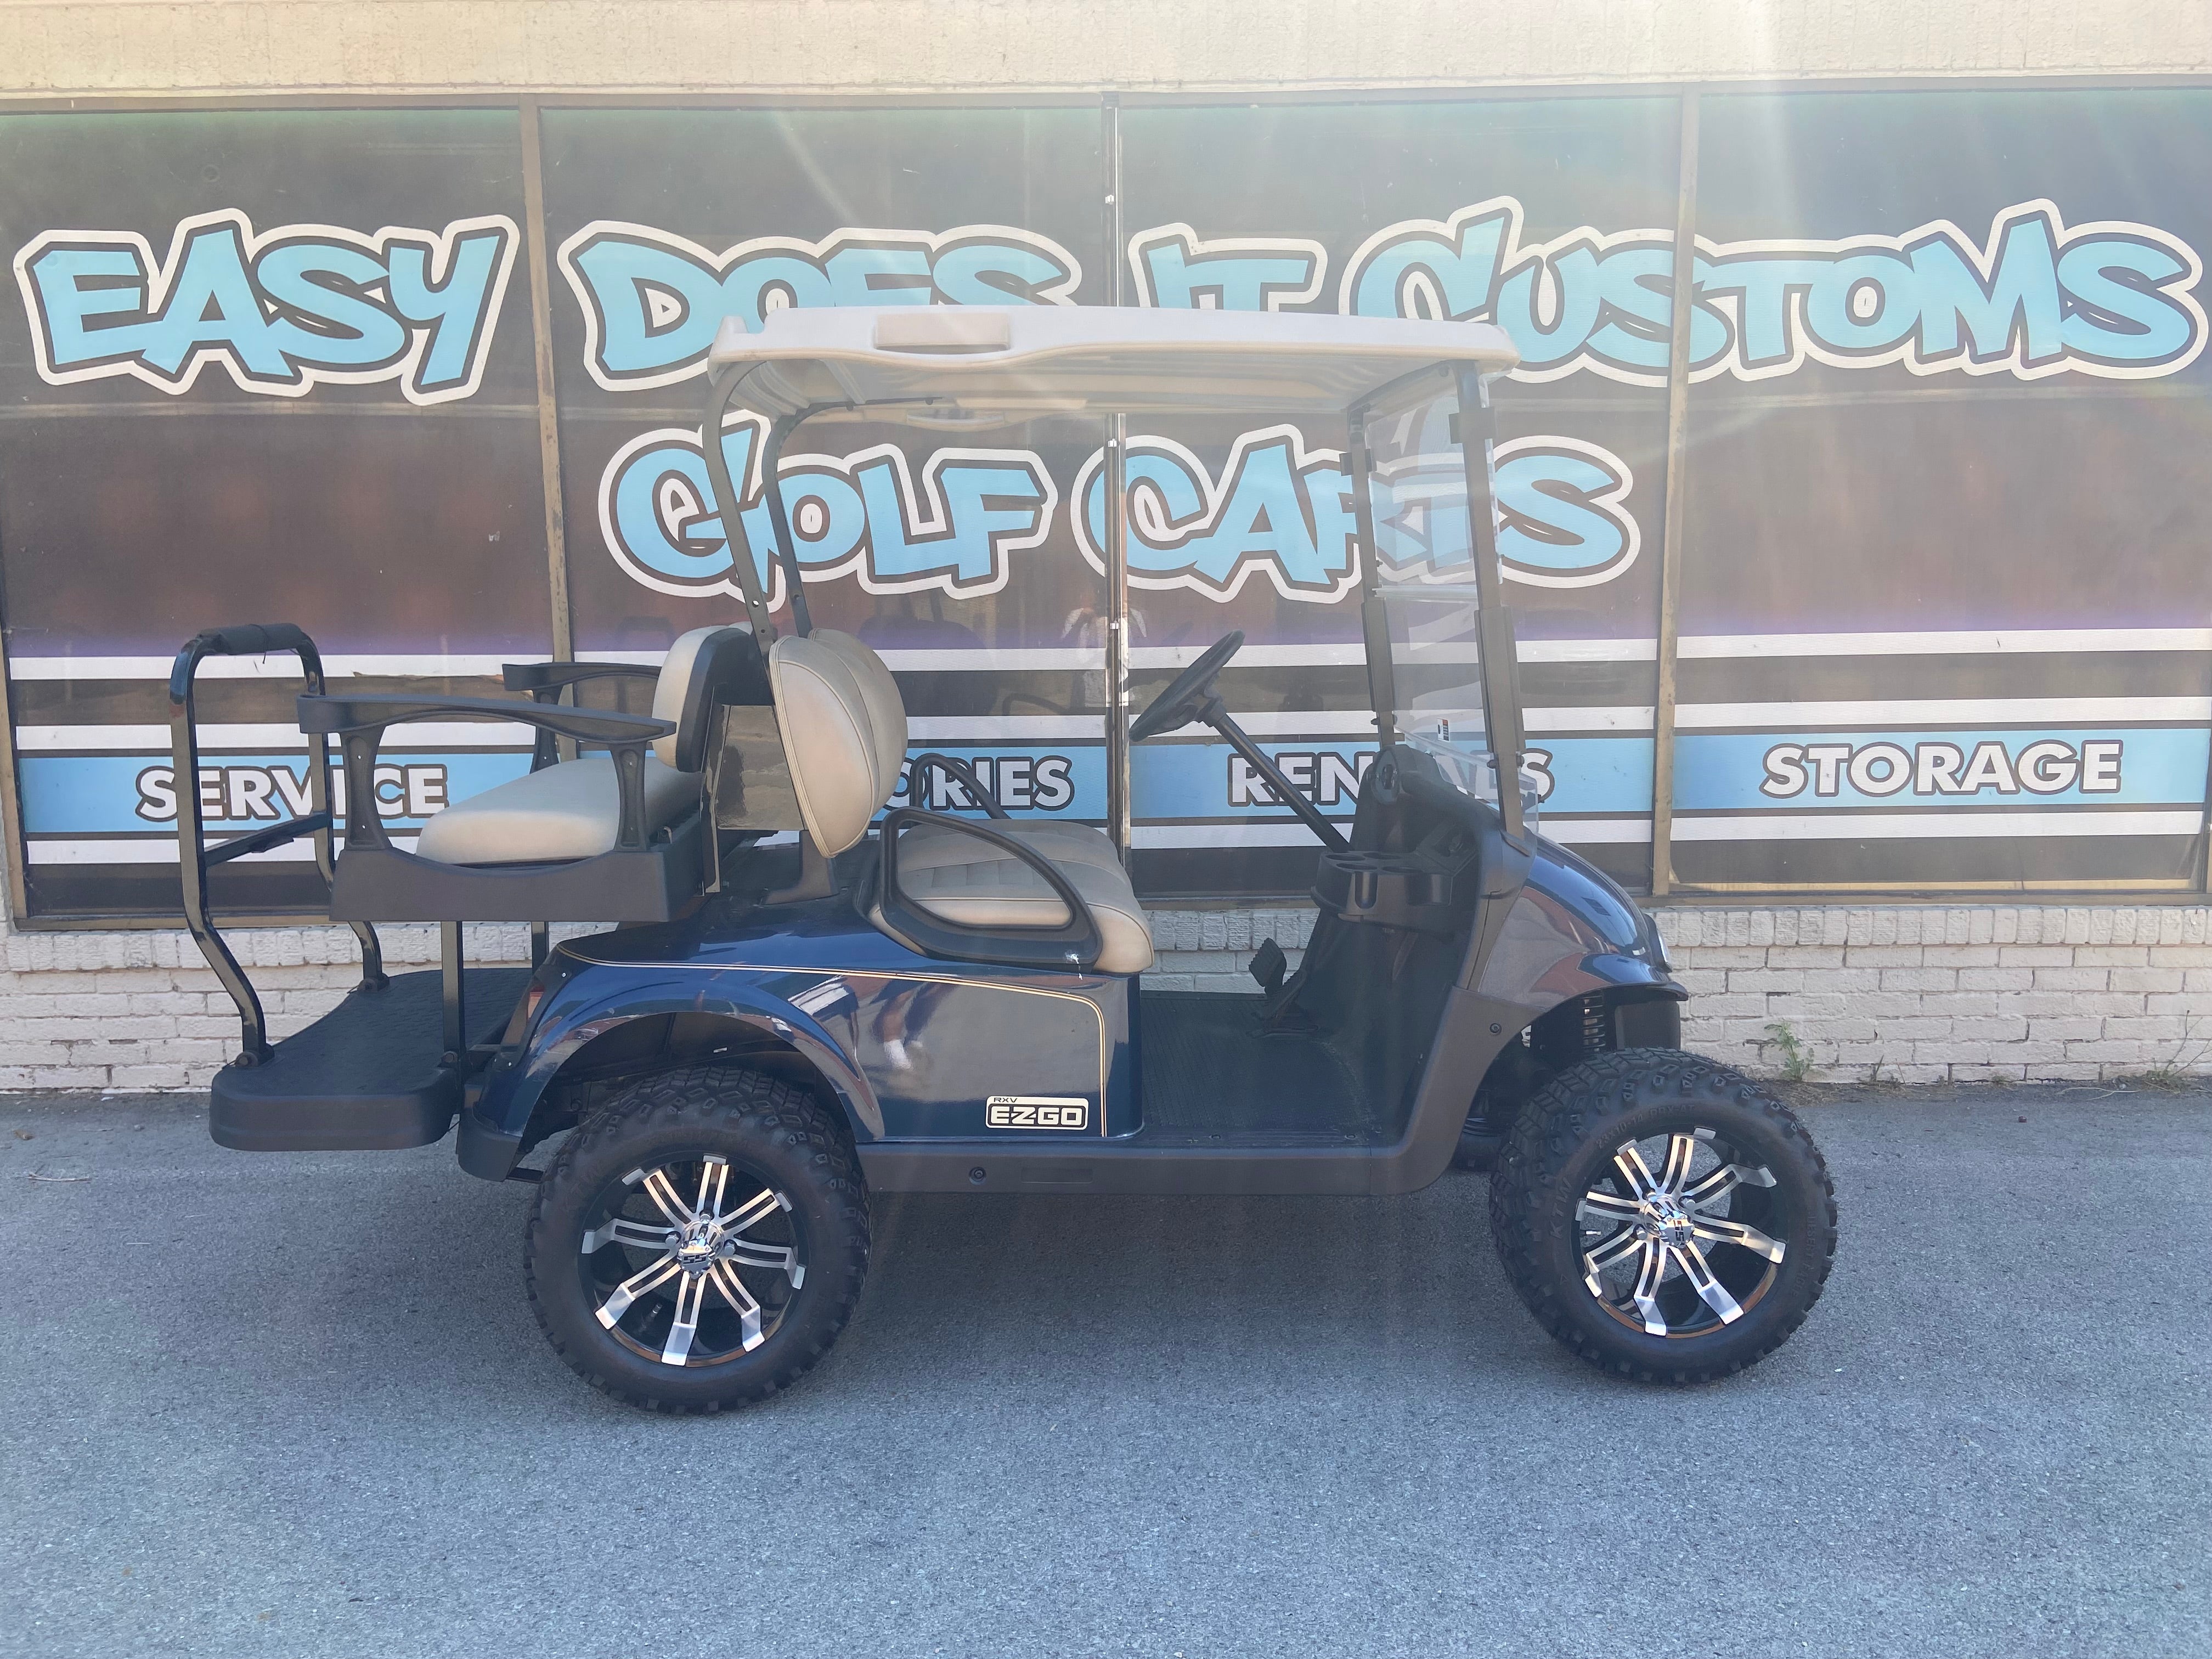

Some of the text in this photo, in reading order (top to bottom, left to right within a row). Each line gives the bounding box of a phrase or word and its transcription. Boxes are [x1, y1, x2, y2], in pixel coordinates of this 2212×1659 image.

[13, 208, 520, 405] EASY
[1339, 196, 2209, 387] CUSTOMS
[599, 409, 1058, 612] GOLF
[135, 764, 449, 821] SERVICE
[1759, 740, 2123, 797] STORAGE
[990, 1105, 1083, 1126] EZGO
